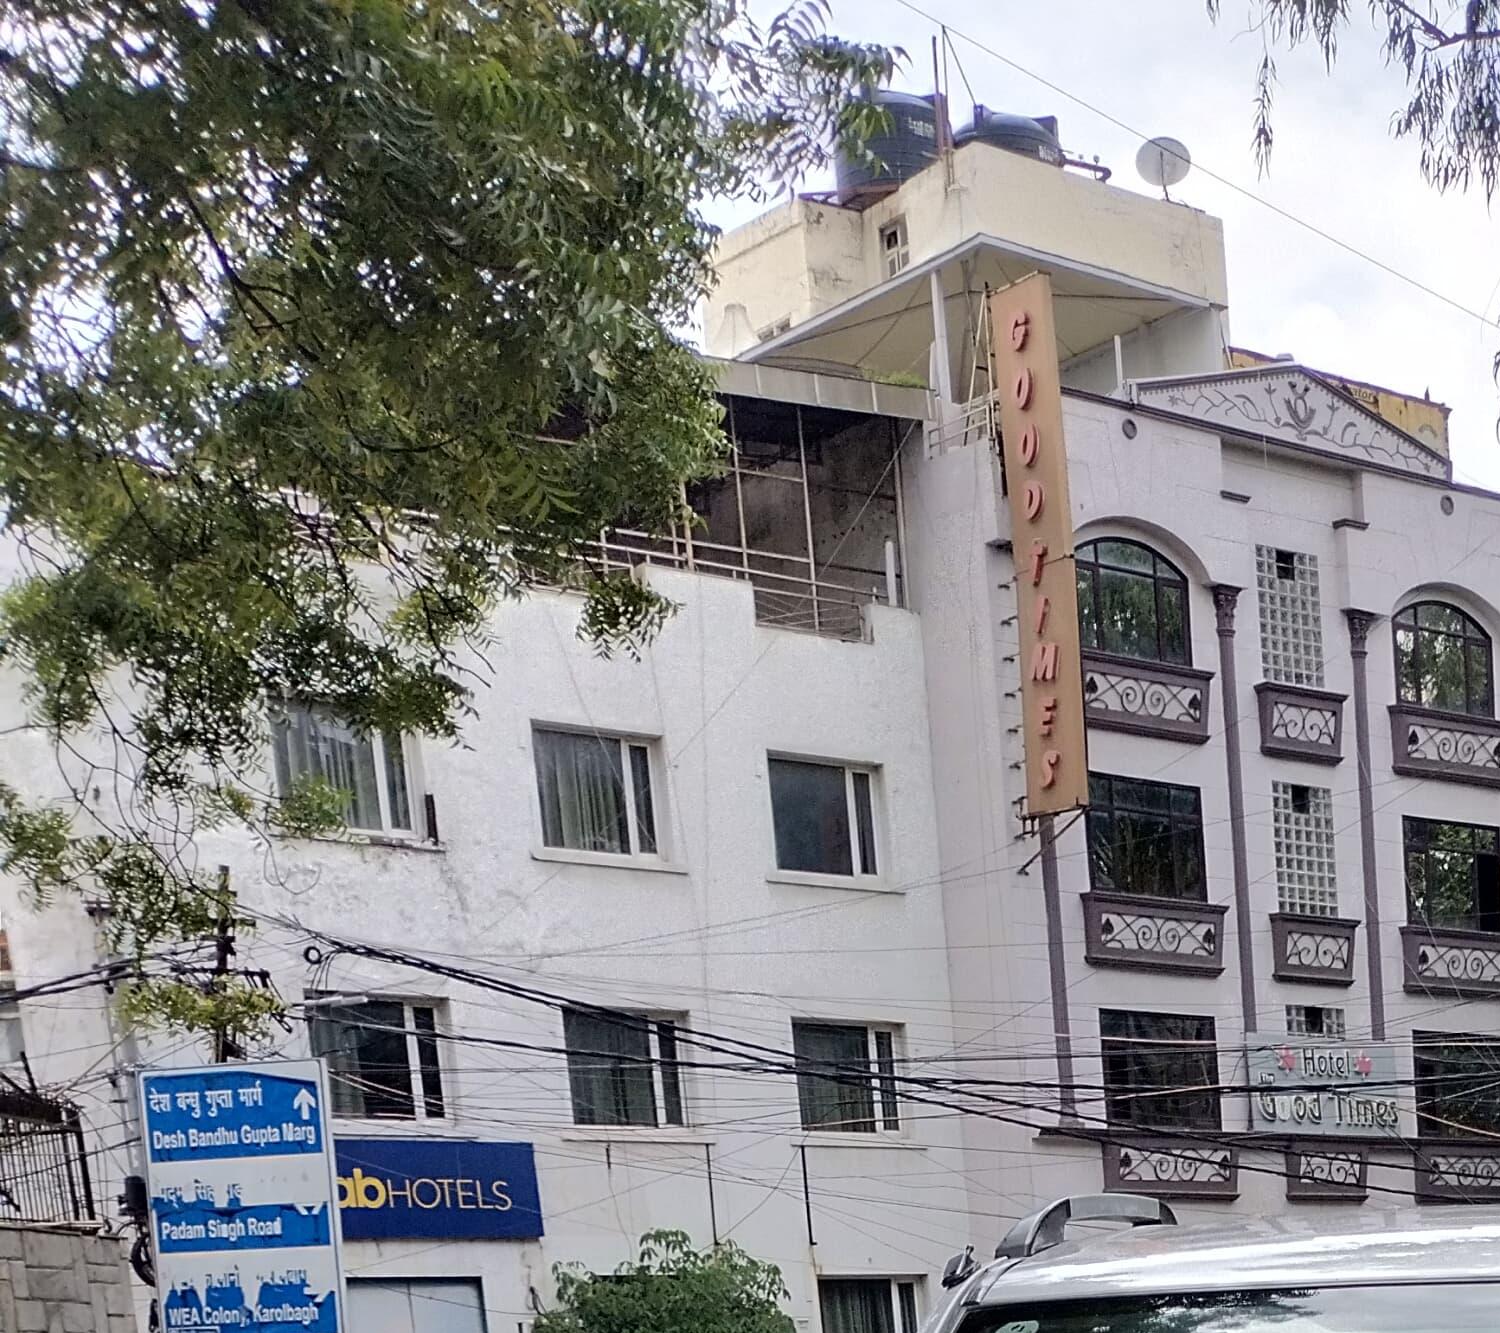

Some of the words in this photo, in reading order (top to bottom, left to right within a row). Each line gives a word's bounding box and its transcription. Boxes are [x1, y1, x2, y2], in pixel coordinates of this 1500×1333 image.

[1301, 1047, 1350, 1078] Hotel
[149, 1088, 171, 1112] देश
[205, 1089, 233, 1117] गुप्ता
[238, 1081, 263, 1107] मार्ग
[1257, 1092, 1322, 1125] Good
[1328, 1094, 1399, 1127] Times
[153, 1130, 186, 1149] Desh
[188, 1127, 239, 1147] Bandhu
[241, 1124, 281, 1147] Gupta
[281, 1123, 316, 1145] Marg
[161, 1221, 206, 1240] Padam
[207, 1219, 245, 1242] Singh
[247, 1217, 282, 1237] Road
[168, 1308, 201, 1327] WEA
[252, 1302, 319, 1326] Karolbagh
